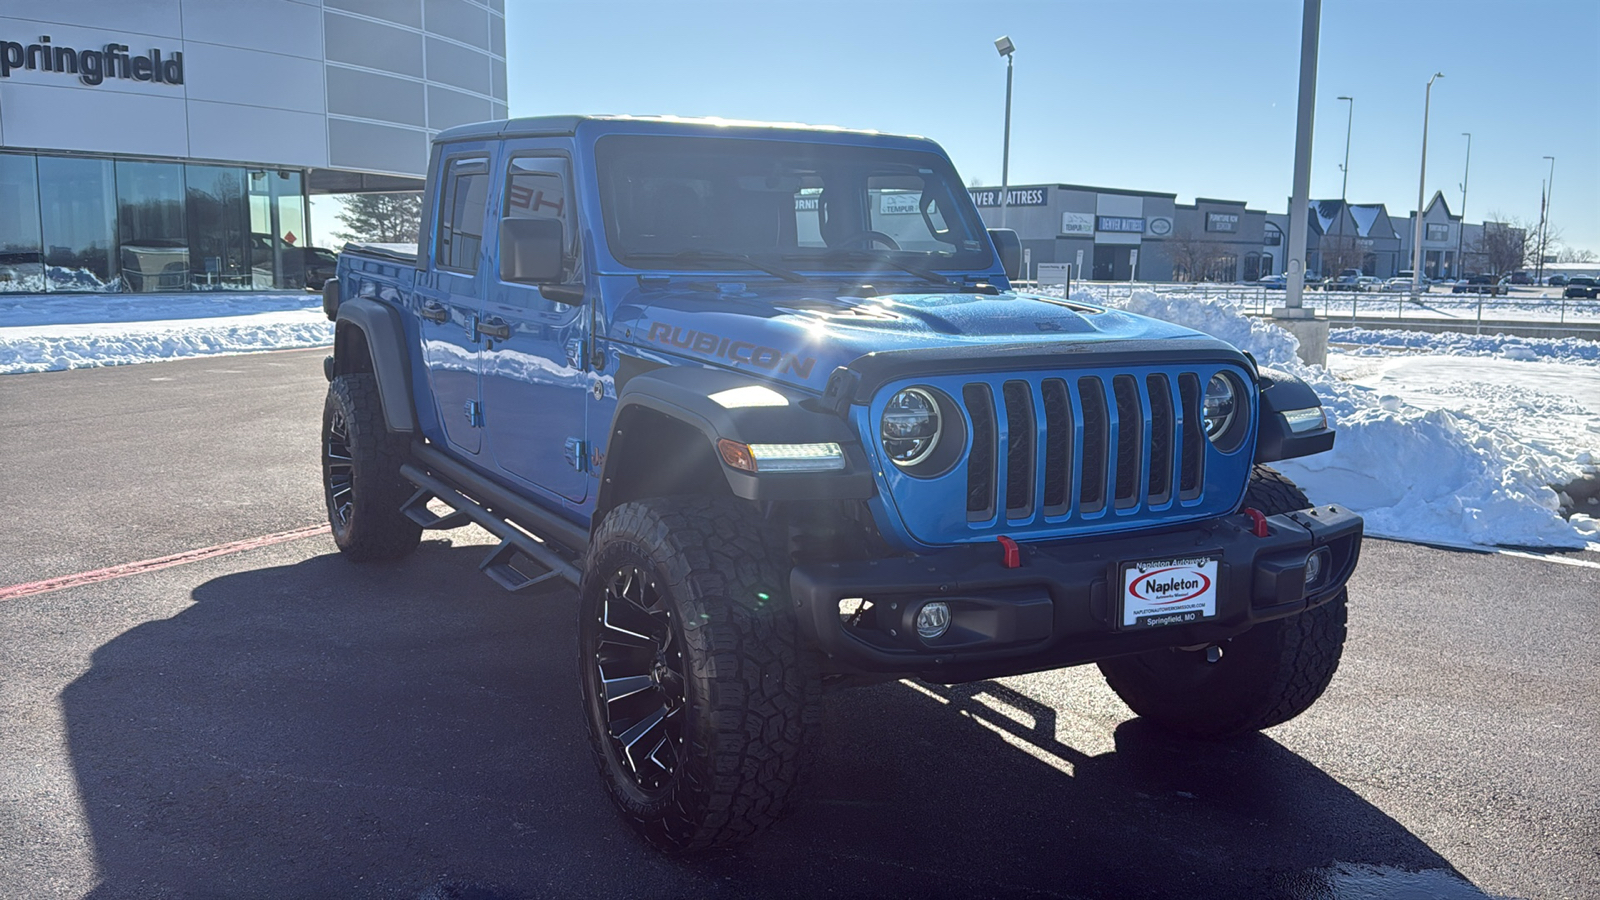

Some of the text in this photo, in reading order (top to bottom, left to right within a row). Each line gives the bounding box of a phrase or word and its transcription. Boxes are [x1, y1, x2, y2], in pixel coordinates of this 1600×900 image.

[0, 35, 184, 85] pringfield
[1102, 217, 1121, 231] DENVER
[1122, 219, 1143, 232] MATTRESS
[648, 321, 818, 380] RUBICON
[1136, 561, 1170, 570] Napleton
[1146, 578, 1198, 594] Napleton
[1185, 613, 1195, 621] MO
